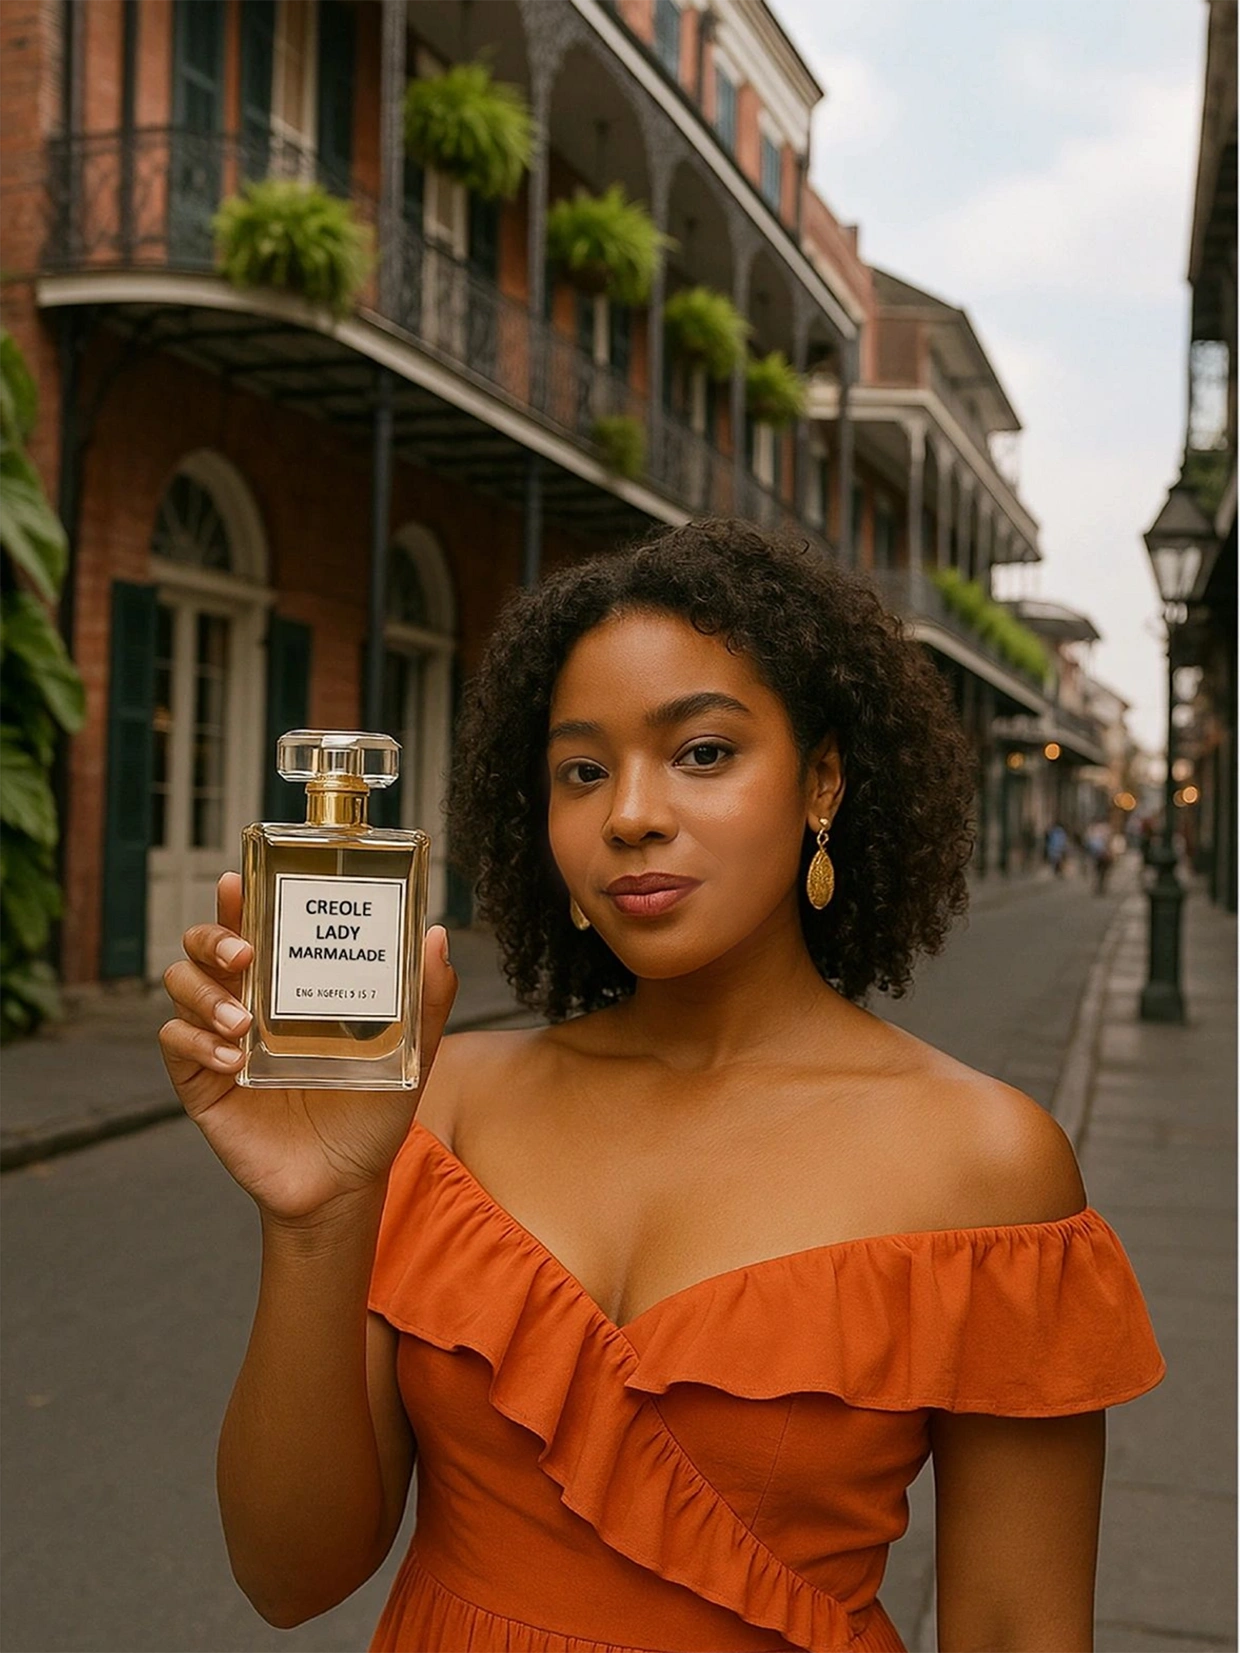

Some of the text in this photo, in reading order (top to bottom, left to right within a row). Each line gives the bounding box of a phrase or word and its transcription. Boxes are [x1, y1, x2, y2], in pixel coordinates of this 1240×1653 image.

[305, 899, 372, 917] CREOLE
[316, 924, 361, 941] LADY
[288, 946, 387, 962] MARMALADE
[295, 987, 314, 999] ENG
